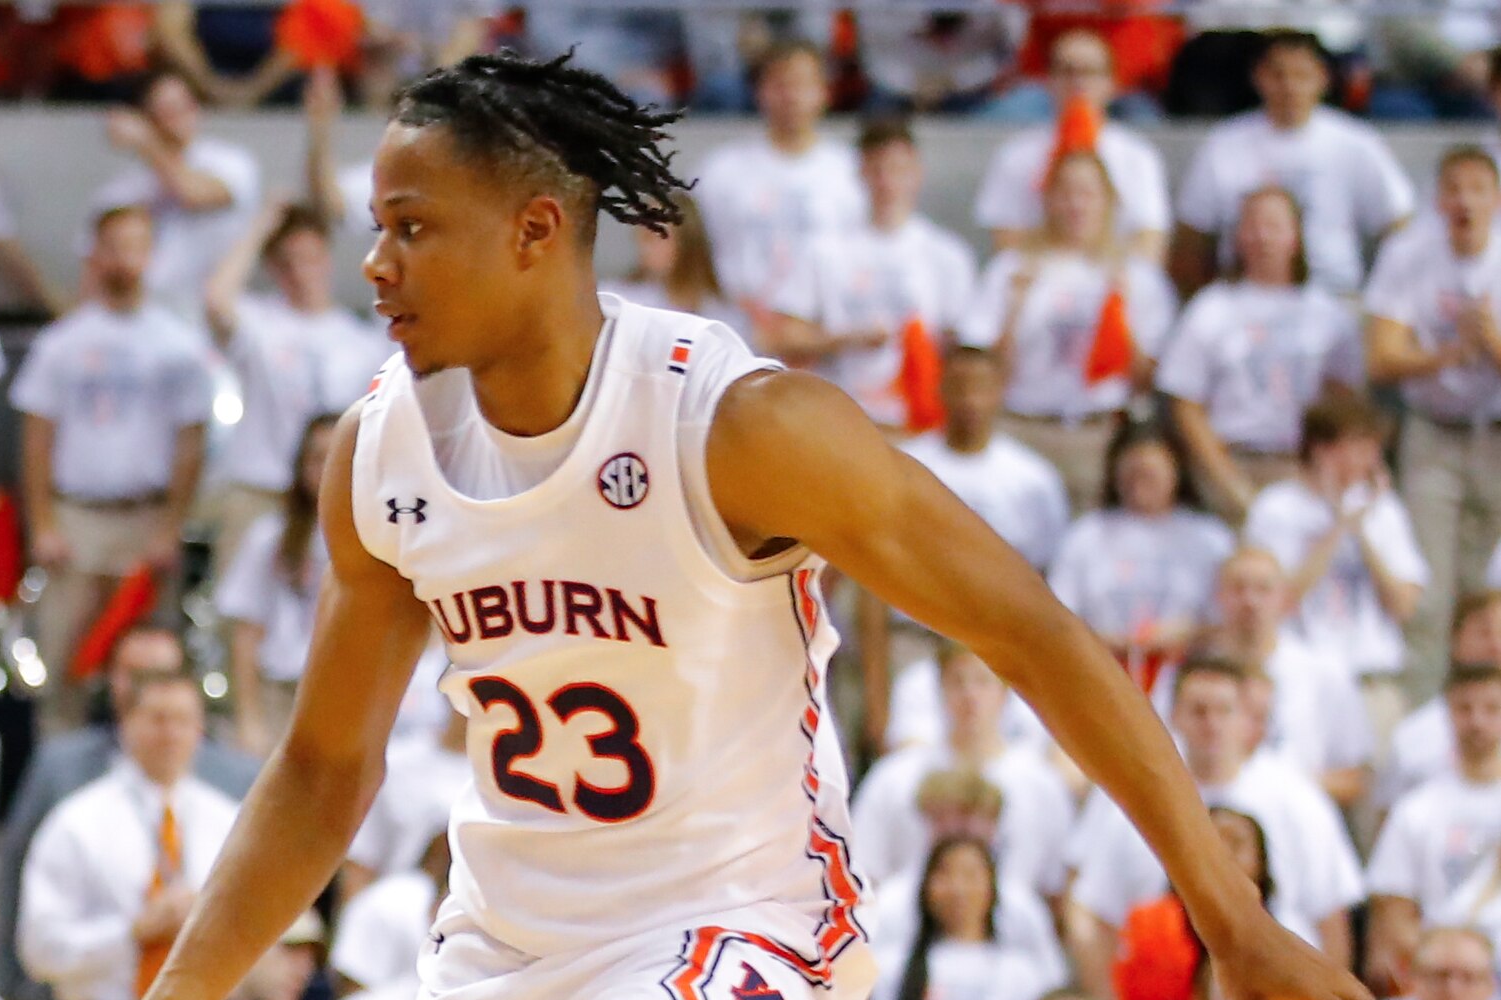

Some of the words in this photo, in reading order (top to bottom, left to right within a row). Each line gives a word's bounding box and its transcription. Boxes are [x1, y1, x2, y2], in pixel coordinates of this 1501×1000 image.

[598, 453, 649, 509] SEC
[426, 580, 668, 648] UBURN
[468, 675, 656, 824] 23
